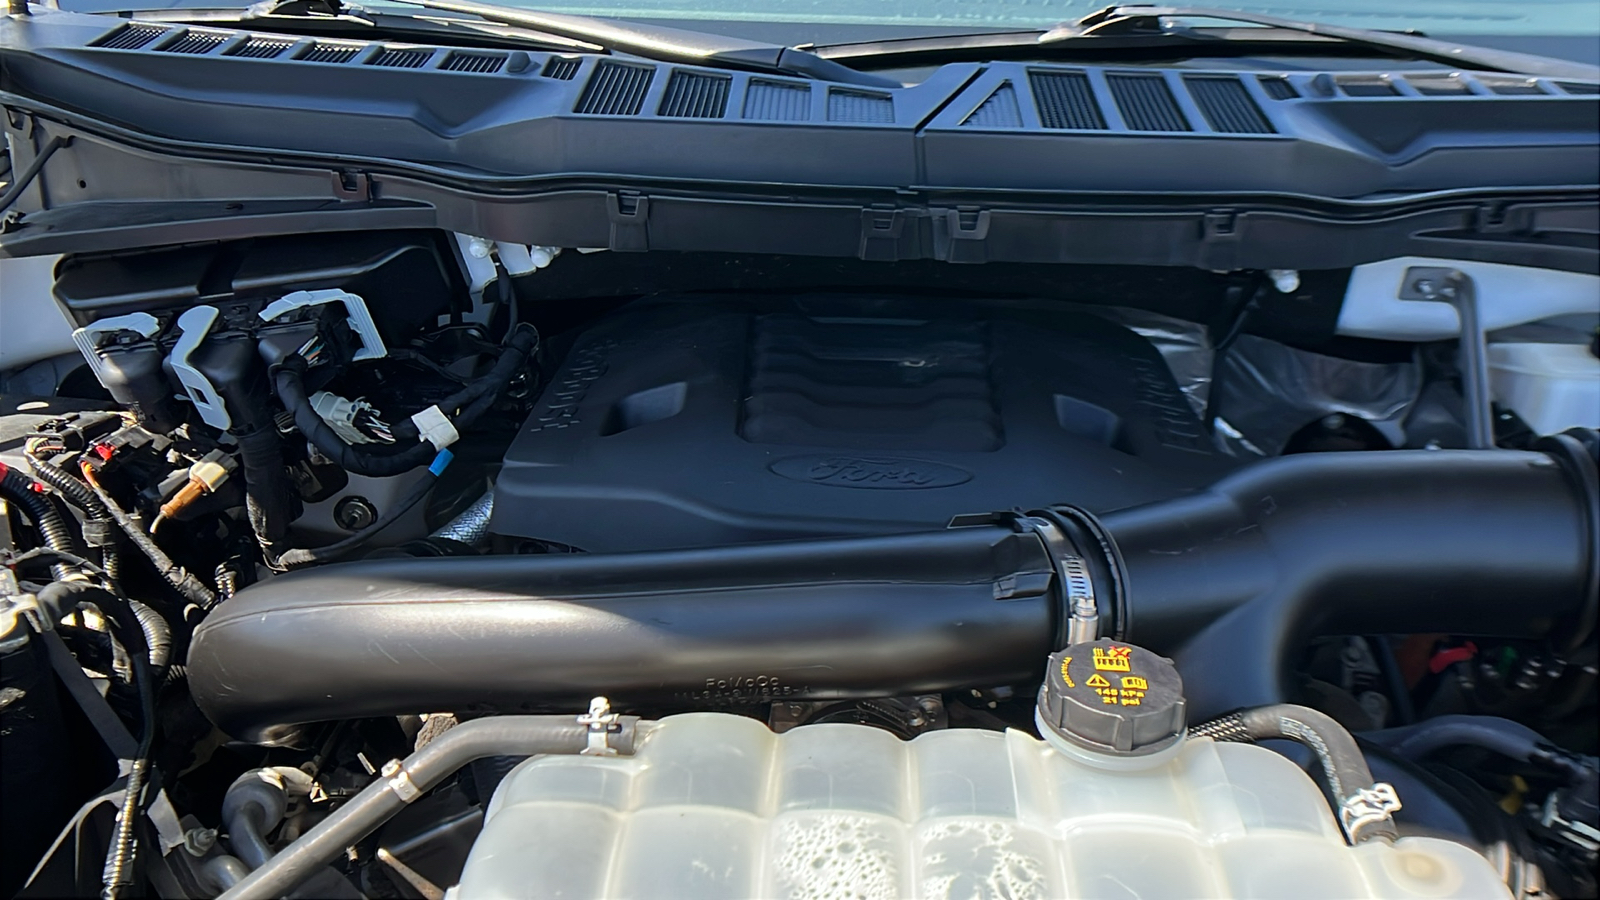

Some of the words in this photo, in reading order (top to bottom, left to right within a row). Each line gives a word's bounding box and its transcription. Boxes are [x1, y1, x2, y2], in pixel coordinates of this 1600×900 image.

[809, 457, 936, 485] Ford
[1102, 696, 1118, 704] 21
[1121, 698, 1141, 707] psi
